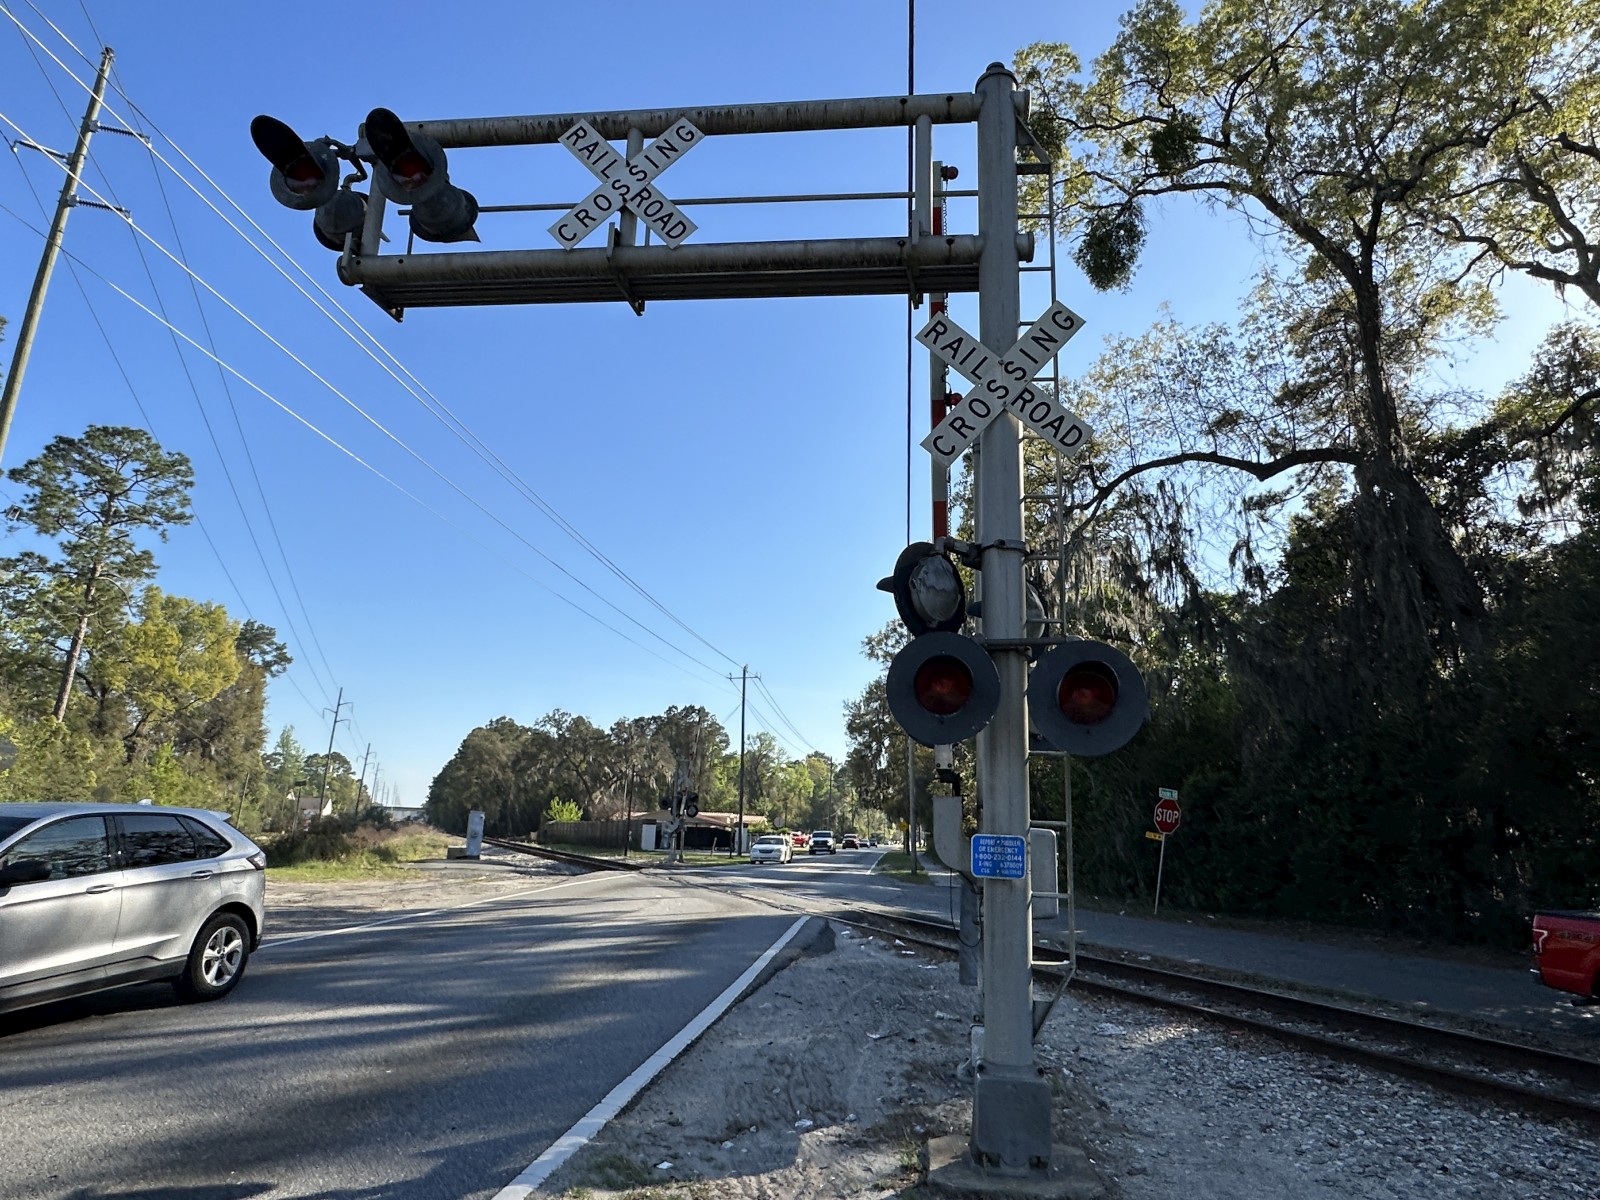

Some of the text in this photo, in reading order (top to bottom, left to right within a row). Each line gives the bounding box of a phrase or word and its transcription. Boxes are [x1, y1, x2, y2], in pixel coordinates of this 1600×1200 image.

[557, 125, 696, 242] CROSSING
[566, 125, 687, 240] RAIL ROAD
[924, 320, 1083, 448] RAIL ROAD
[932, 310, 1075, 457] CROSSING
[975, 853, 1022, 861] 1-800-232-0144
[987, 846, 1018, 854] EMERGENCY
[1156, 808, 1179, 823] STOP
